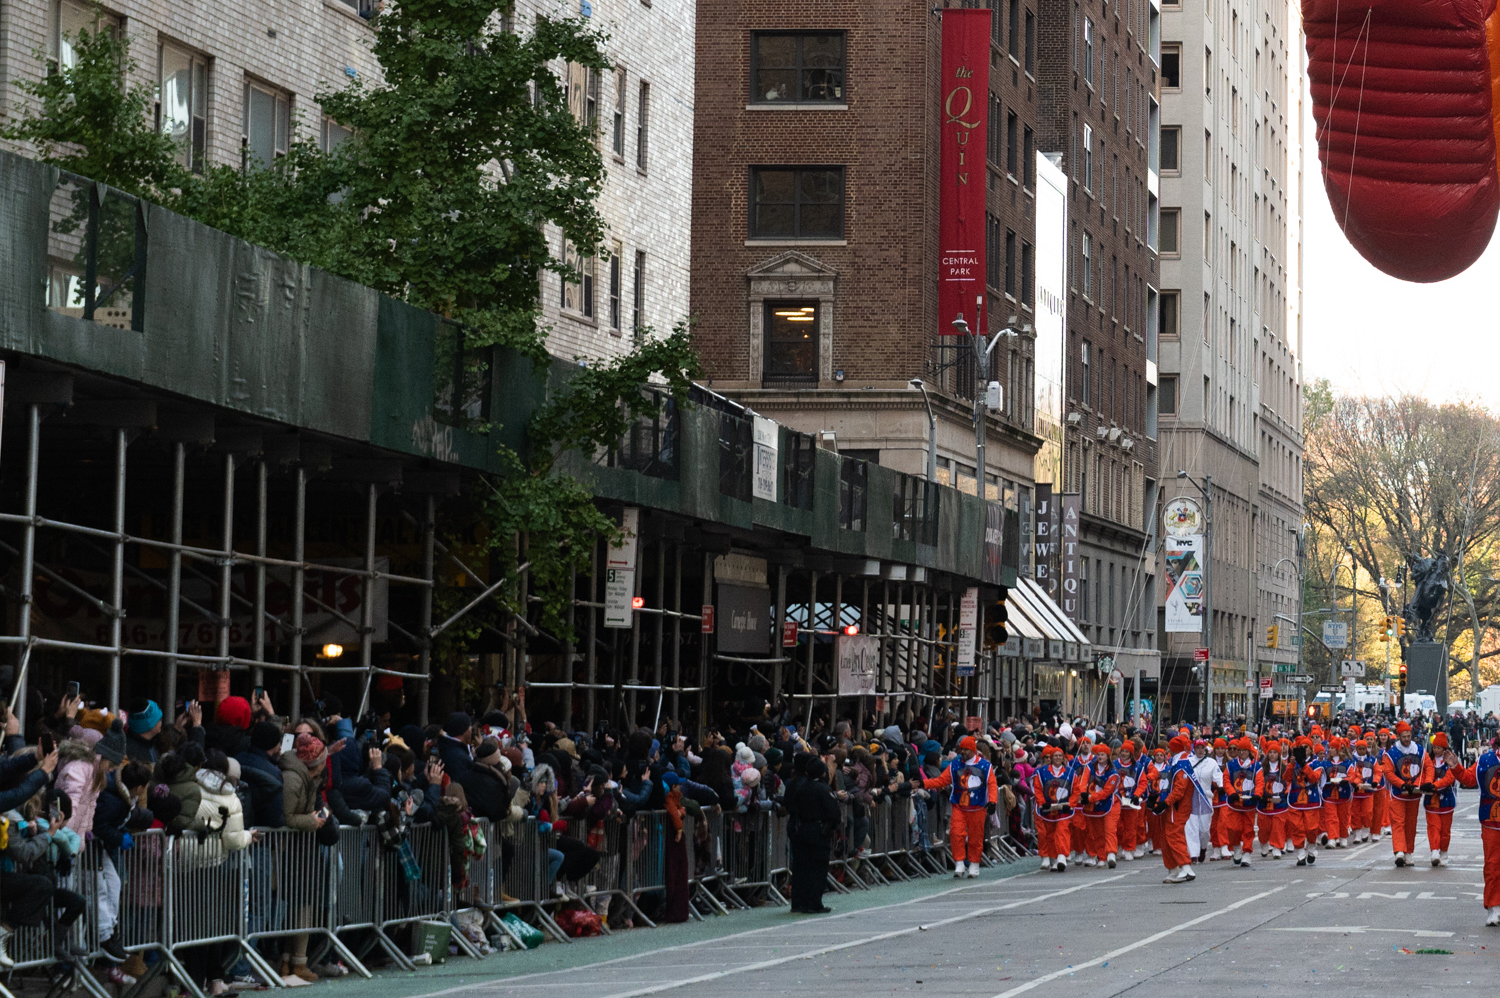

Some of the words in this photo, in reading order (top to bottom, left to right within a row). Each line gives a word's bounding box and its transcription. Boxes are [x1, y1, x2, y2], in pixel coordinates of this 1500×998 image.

[955, 65, 974, 79] the
[944, 85, 982, 186] QUIN
[942, 256, 979, 266] CENTRAL
[949, 266, 971, 277] PARK
[1036, 499, 1050, 589] JEWE
